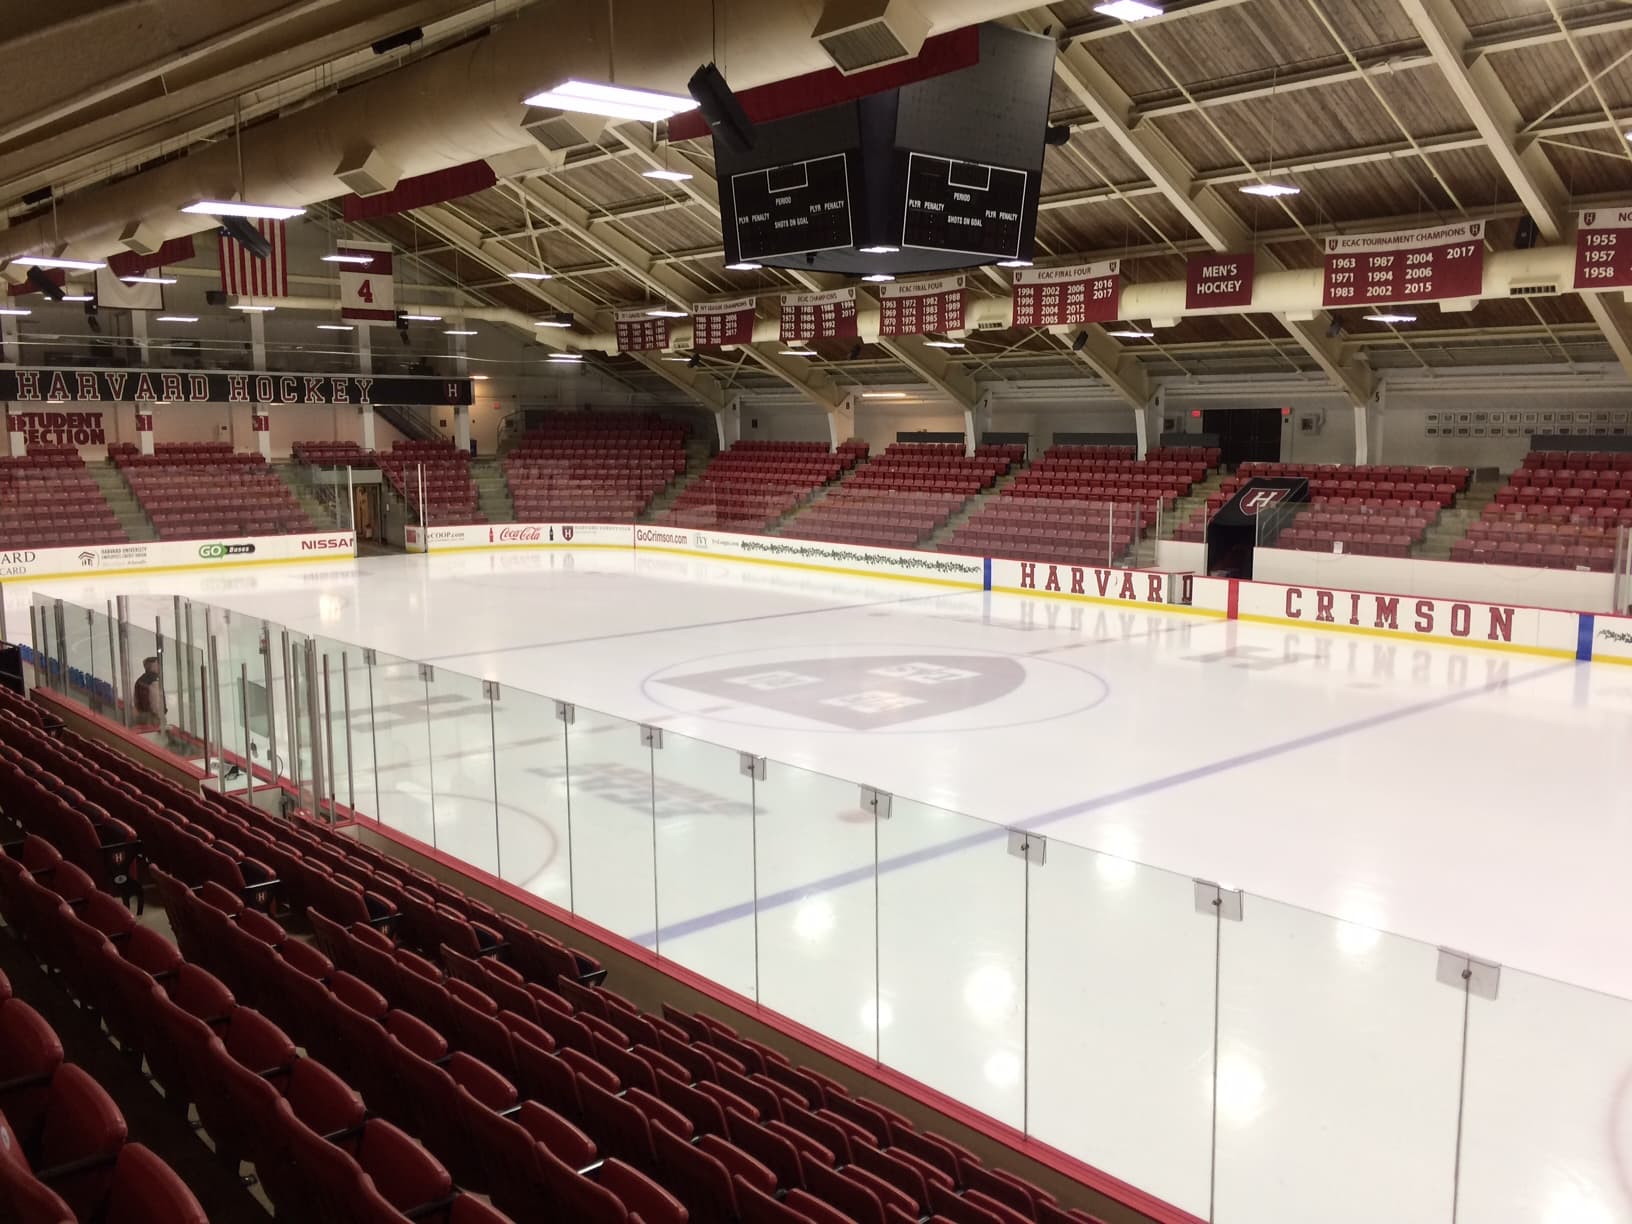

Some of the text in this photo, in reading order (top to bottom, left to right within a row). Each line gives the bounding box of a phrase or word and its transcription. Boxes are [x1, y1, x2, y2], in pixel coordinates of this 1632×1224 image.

[954, 192, 970, 202] PERIOD
[824, 201, 844, 210] PENALTY
[909, 199, 944, 212] PLYR PENALTY
[752, 213, 769, 222] PENALTY
[985, 210, 1018, 221] PLYR PENALTY
[1342, 238, 1361, 247] ECAC
[1362, 235, 1414, 246] TOURNAMENT
[1416, 228, 1466, 241] CHAMPIONS
[1586, 234, 1616, 246] 1955
[1332, 246, 1474, 269] 1963 1987 2004 2017
[1585, 251, 1615, 262] 1957
[1038, 267, 1091, 279] ECAC FINAL FOUR
[1202, 264, 1237, 278] MEN'S
[1331, 267, 1432, 283] 1971 1994 2006
[1584, 267, 1614, 278] 1958
[357, 280, 373, 303] 4
[1042, 287, 1060, 295] 2002
[1067, 284, 1085, 293] 2006
[1094, 279, 1113, 290] 2016
[1196, 280, 1242, 294] HOCKEY
[1330, 282, 1432, 297] 1983 2002 2015
[1041, 296, 1059, 305] 2003
[1093, 289, 1112, 299] 2017
[1017, 304, 1085, 315] 1998 2004 2012
[1066, 314, 1085, 323] 2015
[16, 371, 373, 404] HARVARD HOCKEY
[448, 384, 458, 397] H
[500, 527, 541, 542] Coca-Cola
[637, 529, 688, 545] GoCrimson.com
[200, 545, 221, 557] GO
[1020, 563, 1193, 602] HARVARD
[1285, 588, 1515, 642] CRIMSON
